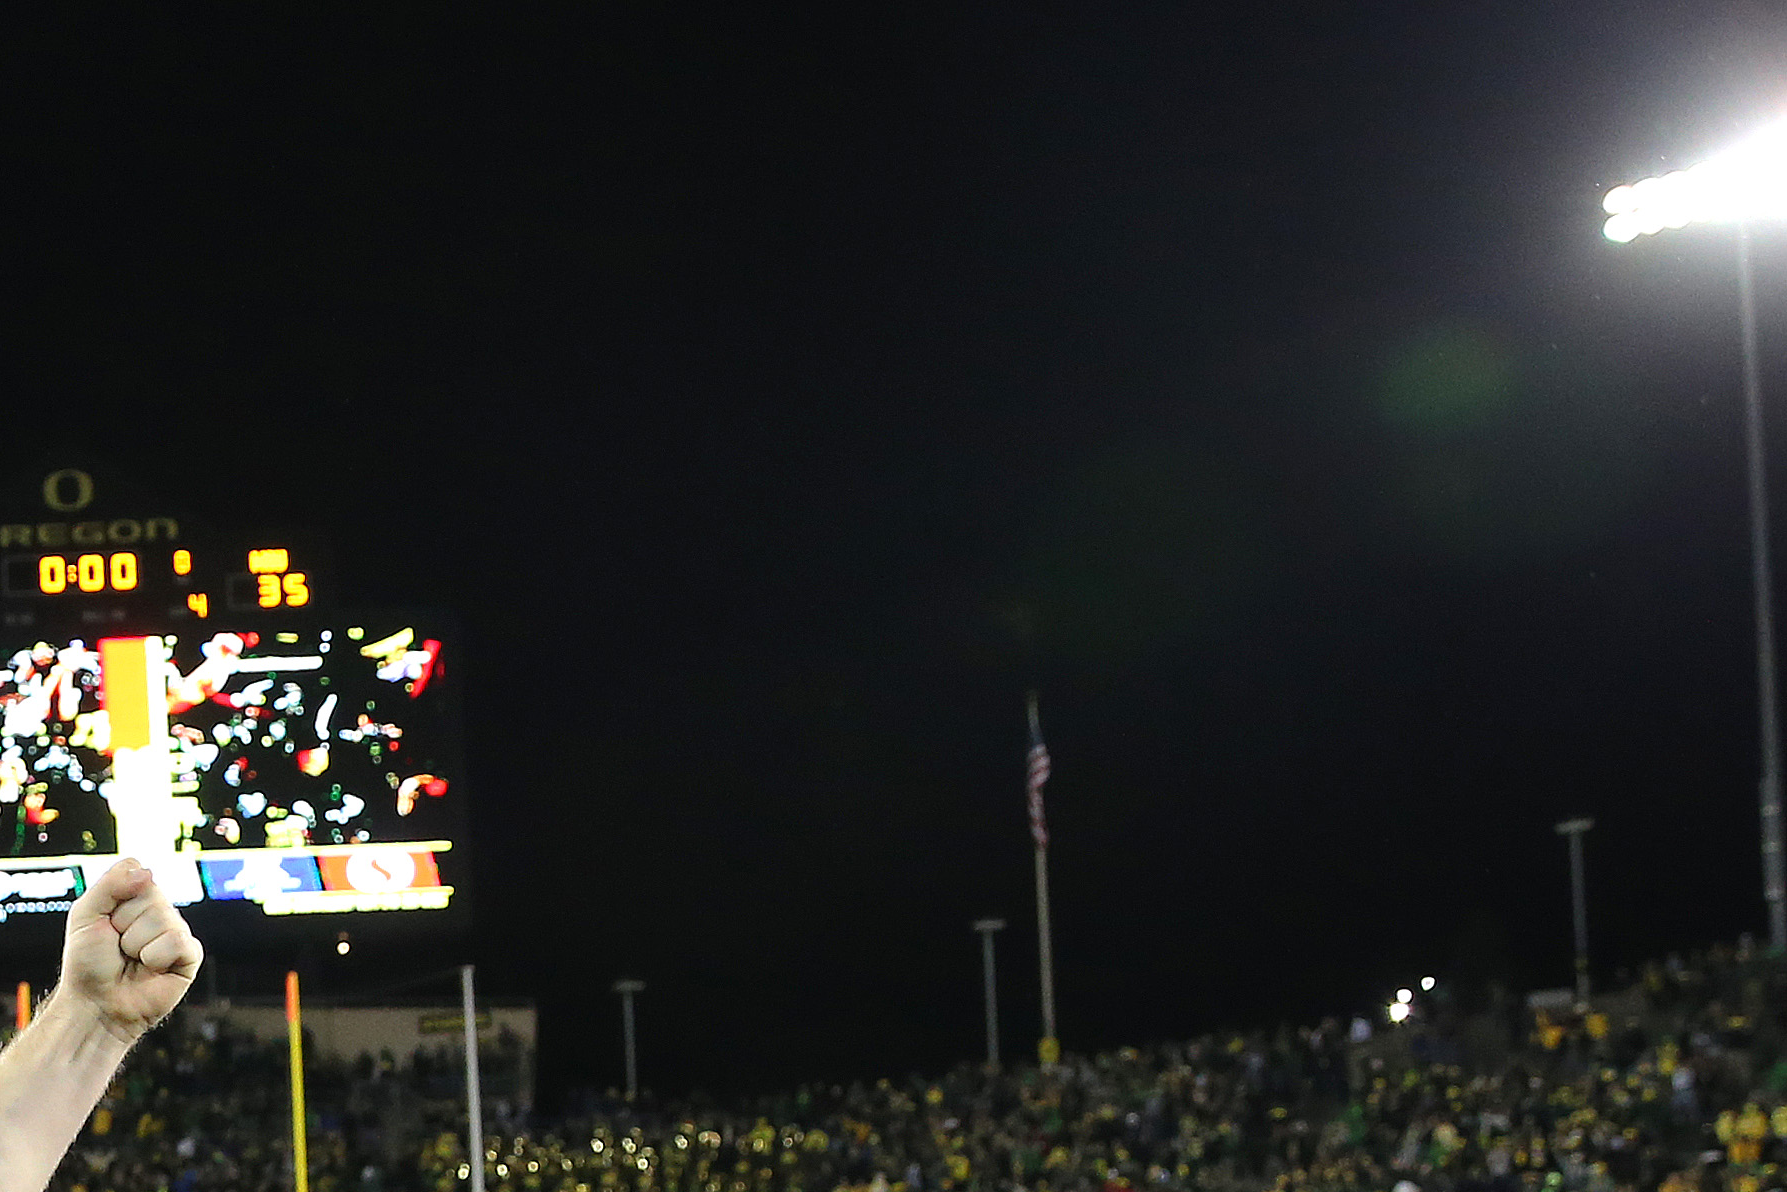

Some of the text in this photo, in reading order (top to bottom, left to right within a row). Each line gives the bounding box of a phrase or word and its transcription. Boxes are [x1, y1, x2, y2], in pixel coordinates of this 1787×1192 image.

[39, 552, 138, 594] 0:00
[258, 572, 309, 608] 35
[188, 593, 209, 618] 4
